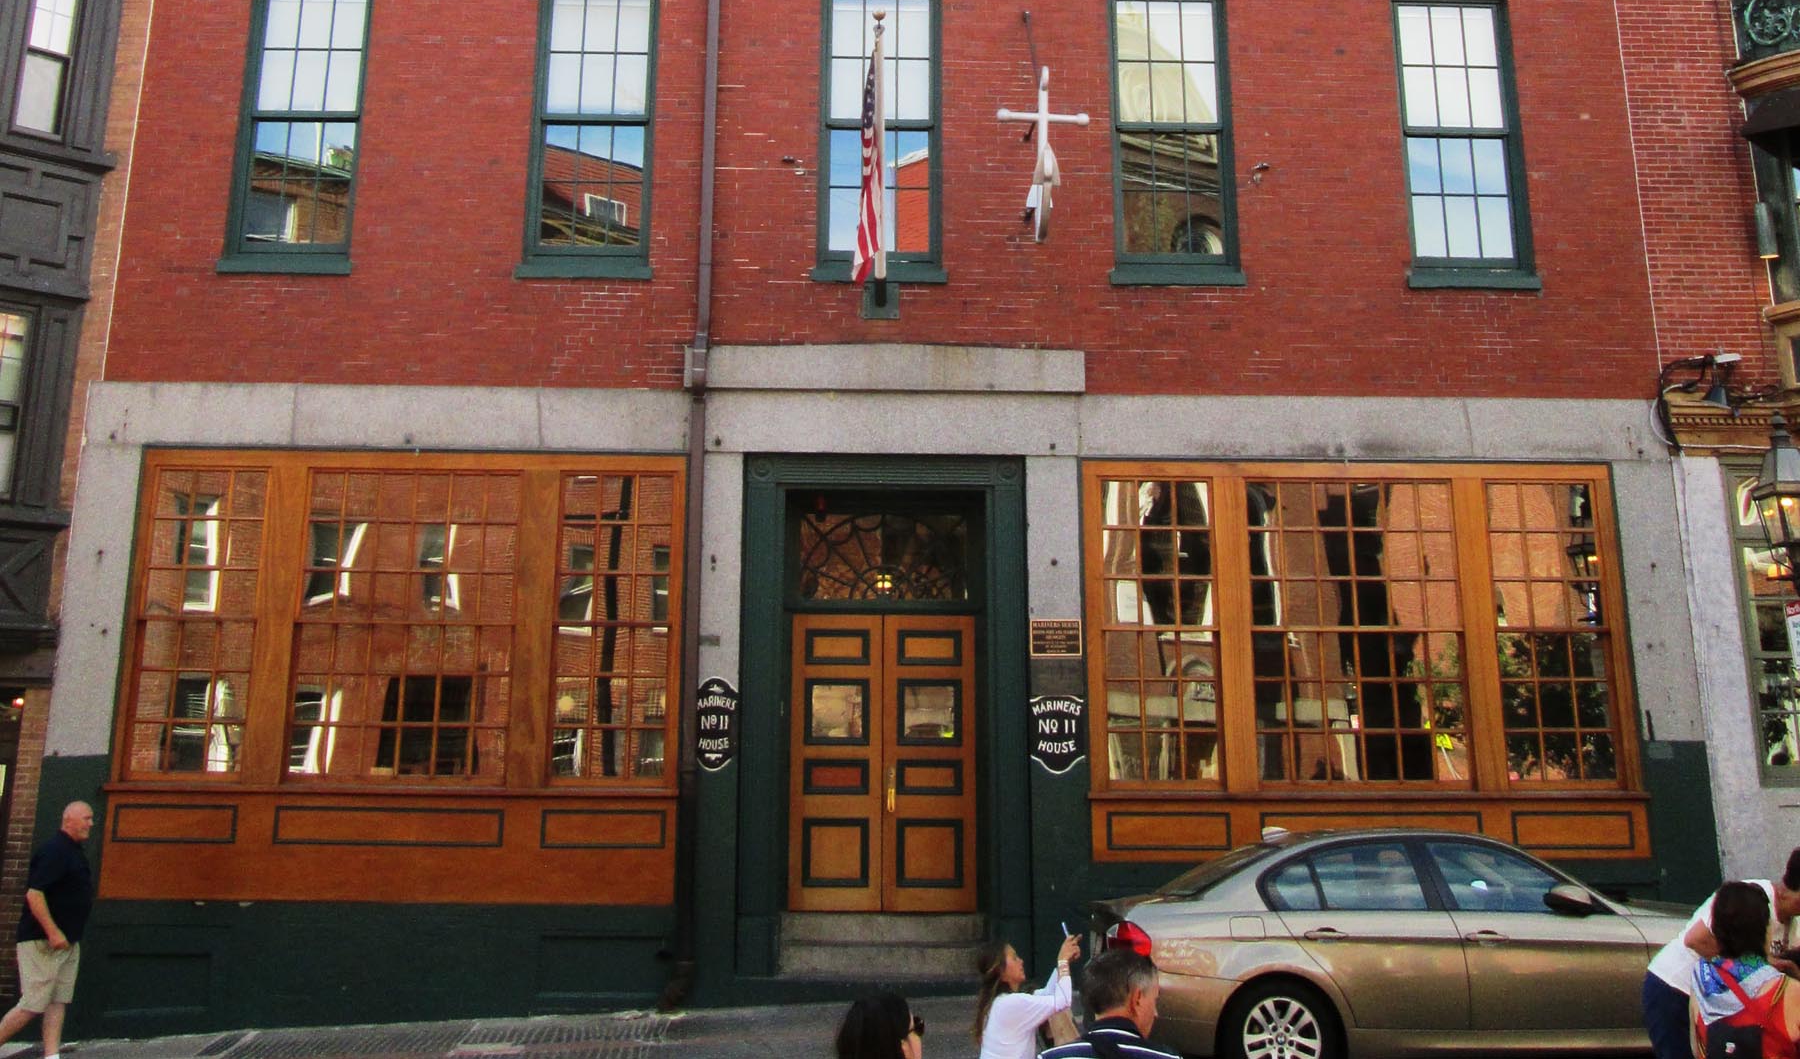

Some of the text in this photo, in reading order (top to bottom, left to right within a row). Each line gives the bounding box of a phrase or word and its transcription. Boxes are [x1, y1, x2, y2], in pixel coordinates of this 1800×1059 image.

[697, 696, 737, 710] MARINERS
[1032, 700, 1082, 716] MARINERS
[720, 715, 729, 730] 11
[1064, 719, 1076, 734] 11
[698, 737, 729, 751] HOUSE
[1038, 739, 1077, 754] HOUSE
